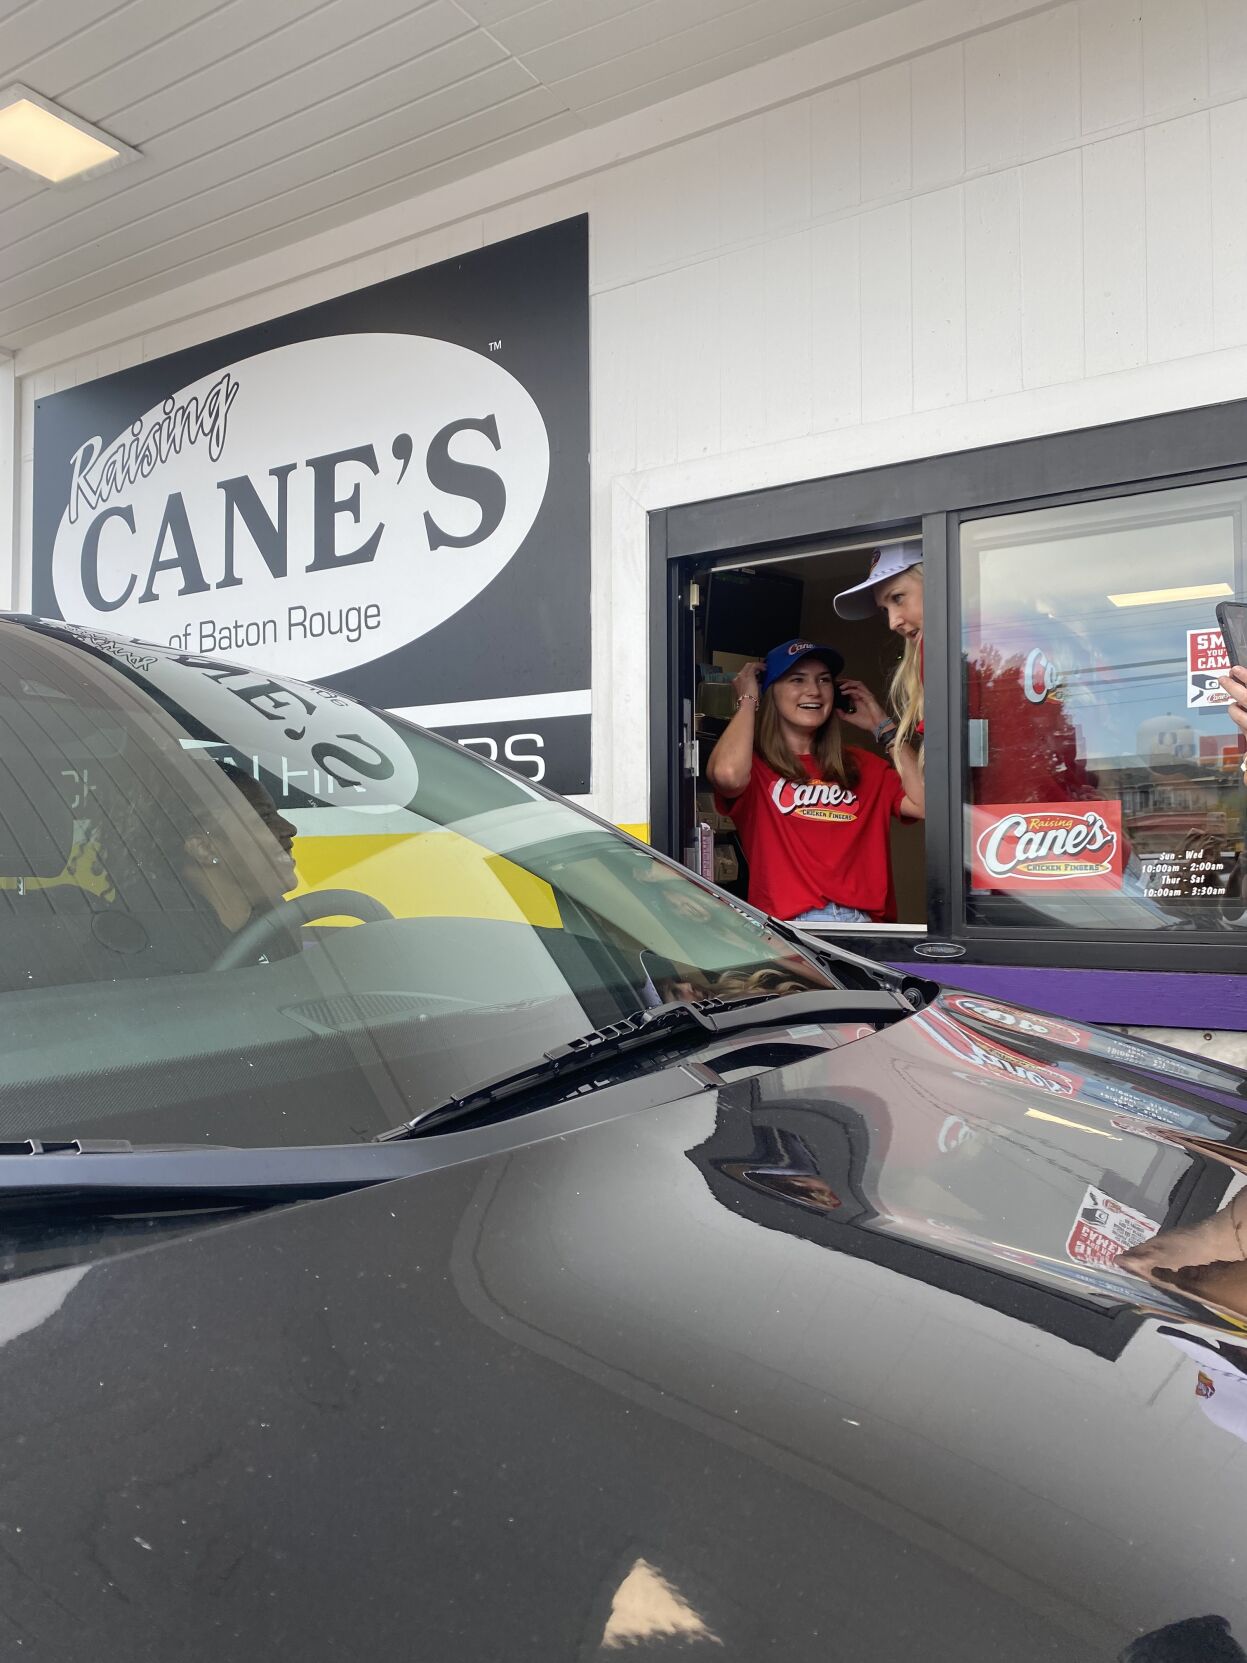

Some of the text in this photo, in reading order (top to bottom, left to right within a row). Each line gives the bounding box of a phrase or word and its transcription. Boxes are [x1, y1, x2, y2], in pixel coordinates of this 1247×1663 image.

[68, 373, 239, 524] Raising
[80, 413, 507, 613] CANE'S
[200, 619, 277, 653] Baton
[288, 603, 381, 643] Rouge
[1197, 633, 1226, 649] SM
[1198, 656, 1230, 668] CAM
[1029, 817, 1073, 829] Raising
[985, 813, 1113, 873] Cane's
[1160, 851, 1175, 860] Sun
[1186, 849, 1204, 859] Wed
[1026, 863, 1101, 871] CHICKEN FINGERS
[1142, 864, 1180, 873] 10:00am
[1190, 862, 1224, 871] 2:00am
[1161, 875, 1180, 884] Thur
[1190, 874, 1205, 884] Sat
[1143, 888, 1182, 897] 10:00am
[1191, 886, 1226, 896] 3:30am
